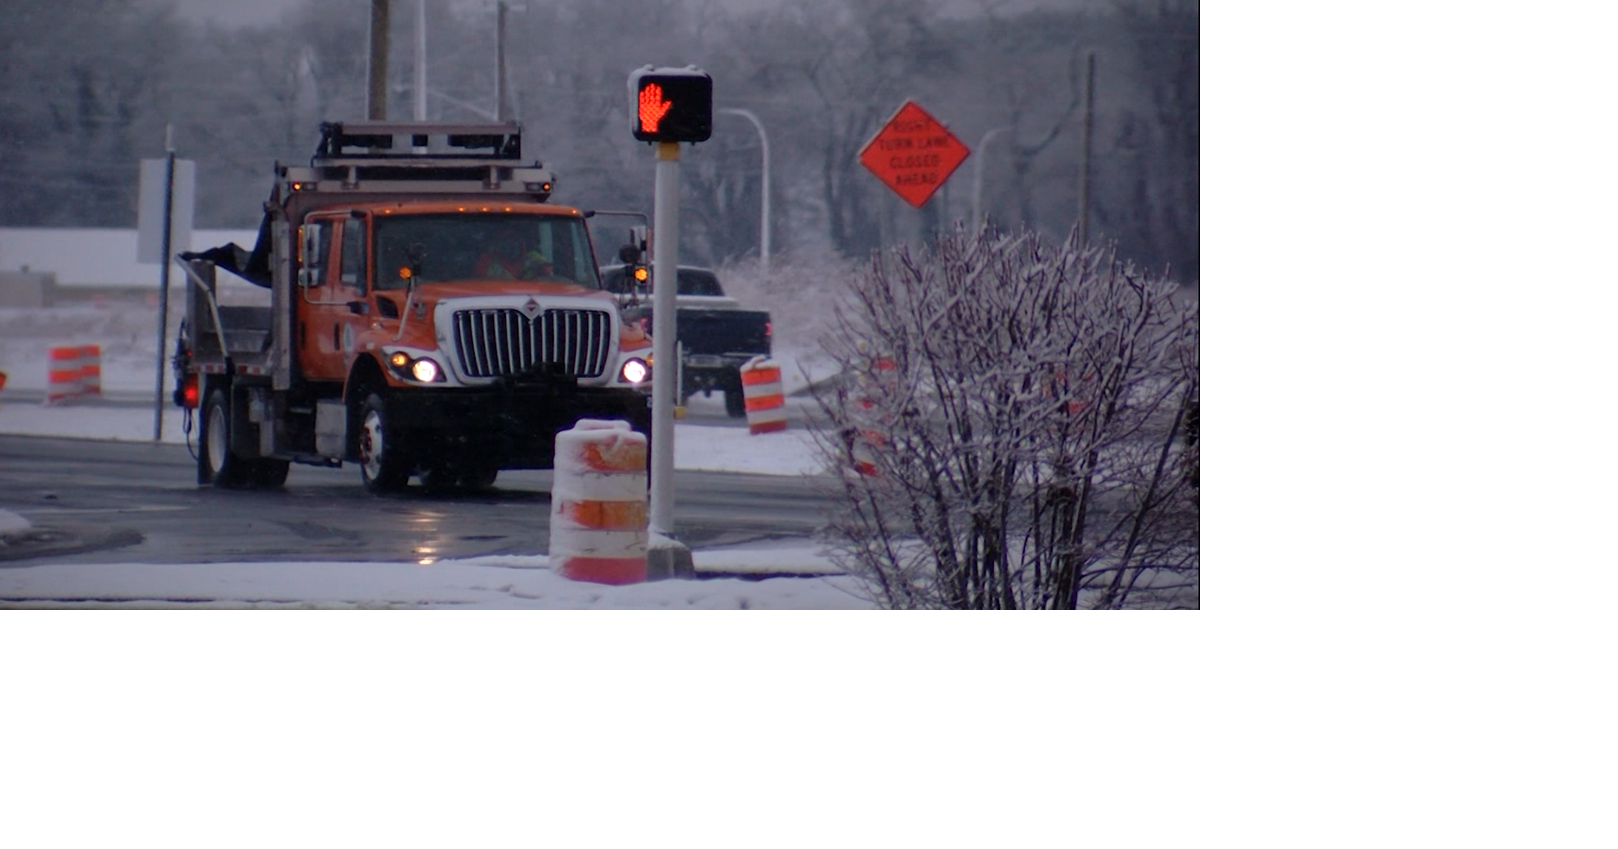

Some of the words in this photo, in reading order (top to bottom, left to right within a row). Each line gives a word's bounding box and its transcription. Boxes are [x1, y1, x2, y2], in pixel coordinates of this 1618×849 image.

[879, 138, 913, 151] TURN
[917, 136, 950, 149] LANE
[889, 154, 941, 169] CLOSED
[895, 172, 938, 185] AHEAD
